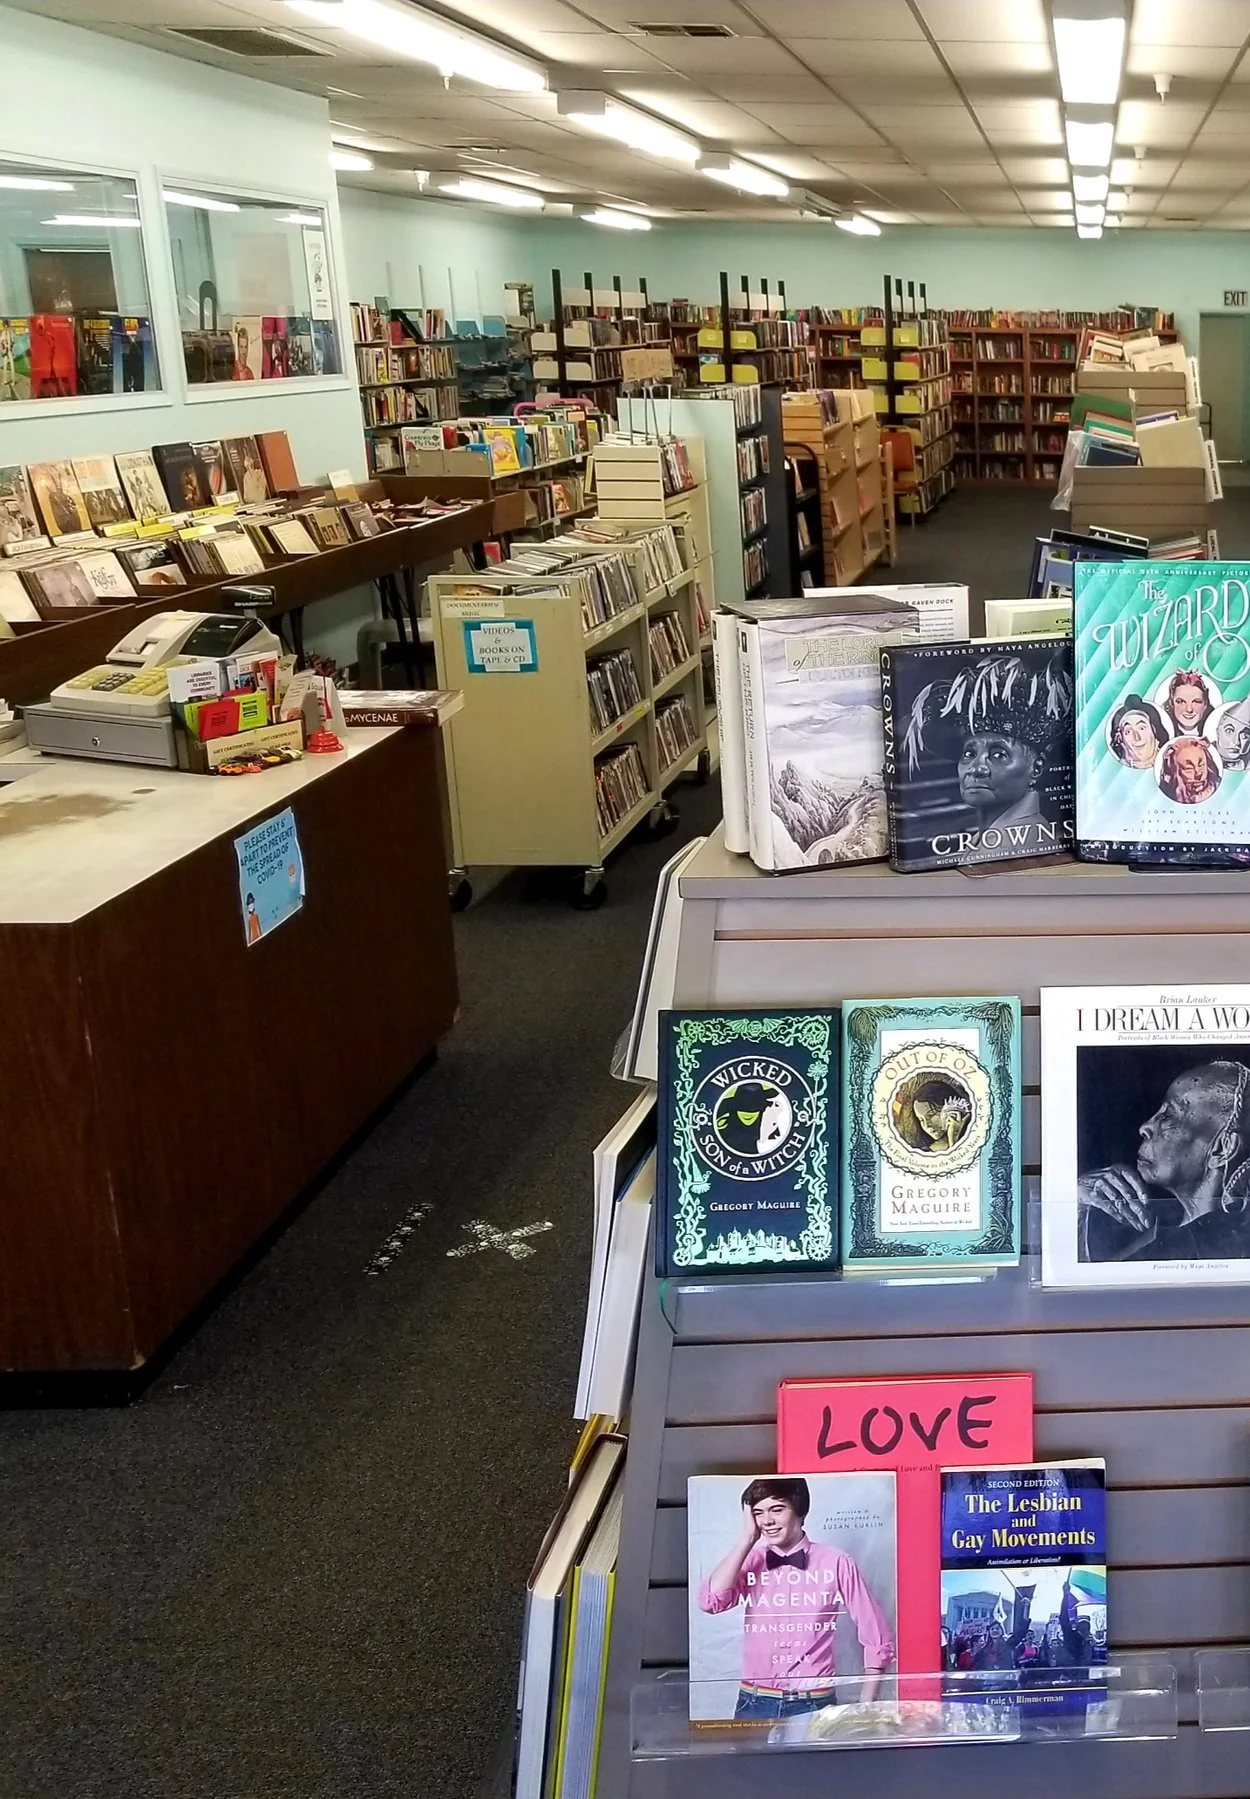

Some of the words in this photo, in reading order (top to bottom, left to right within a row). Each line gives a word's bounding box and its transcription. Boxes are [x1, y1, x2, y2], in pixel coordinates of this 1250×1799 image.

[1223, 290, 1248, 307] EXIT
[1138, 579, 1167, 601] The
[482, 626, 516, 635] VIDEOS
[1092, 578, 1250, 671] WIZARD
[479, 646, 510, 655] BOOKS
[511, 645, 525, 654] ON
[802, 639, 841, 653] THE
[841, 635, 888, 651] LORD
[919, 648, 974, 659] FOREWORD
[997, 644, 1023, 652] MAYA
[1028, 640, 1073, 650] ANGELOU
[1185, 642, 1202, 662] of
[480, 656, 502, 665] TAPE
[513, 655, 526, 663] CD
[808, 652, 845, 668] THE
[350, 713, 399, 723] MYCENAE
[881, 653, 896, 775] CROWNS
[244, 830, 266, 852] PLEASE
[266, 821, 281, 839] STAY
[931, 820, 1074, 856] CROWNS
[240, 844, 260, 867] APART
[268, 826, 294, 852] PREVENT
[936, 856, 965, 866] MICHAEL
[966, 851, 1010, 863] CUNNINGHAM
[1017, 847, 1037, 855] CRAIG
[1039, 843, 1071, 852] MARBERRY
[246, 863, 260, 878] THE
[260, 848, 281, 871] SPREAD
[280, 842, 290, 855] OF
[257, 859, 284, 885] COVID-19
[1159, 994, 1184, 1004] Brian
[1076, 1008, 1084, 1032] I
[1094, 1007, 1181, 1032] DREAM
[1187, 1007, 1207, 1031] A
[711, 1060, 793, 1090] WICKED
[884, 1053, 921, 1081] OUT
[925, 1051, 948, 1064] OF
[954, 1054, 979, 1081] OZ
[699, 1133, 732, 1169] SON
[751, 1131, 807, 1174] WITCH
[891, 1185, 972, 1199] GREGORY
[709, 1199, 754, 1212] GREGORY
[757, 1198, 802, 1211] MAGUIRE
[892, 1200, 972, 1215] MAGUIRE
[817, 1394, 997, 1460] LOVE
[987, 1480, 1022, 1489] SECOND
[1024, 1478, 1060, 1488] EDITION
[965, 1494, 1002, 1514] The
[1007, 1492, 1082, 1513] Lesbian
[823, 1523, 850, 1531] SUSAN
[1011, 1514, 1037, 1528] and
[951, 1529, 986, 1554] Gay
[991, 1527, 1096, 1548] Movements
[986, 1558, 1022, 1566] Assimilation
[746, 1568, 835, 1587] BEYOND
[738, 1589, 845, 1608] MAGENTA
[744, 1621, 838, 1634] TRANSGENDER
[771, 1654, 812, 1665] SPEAK
